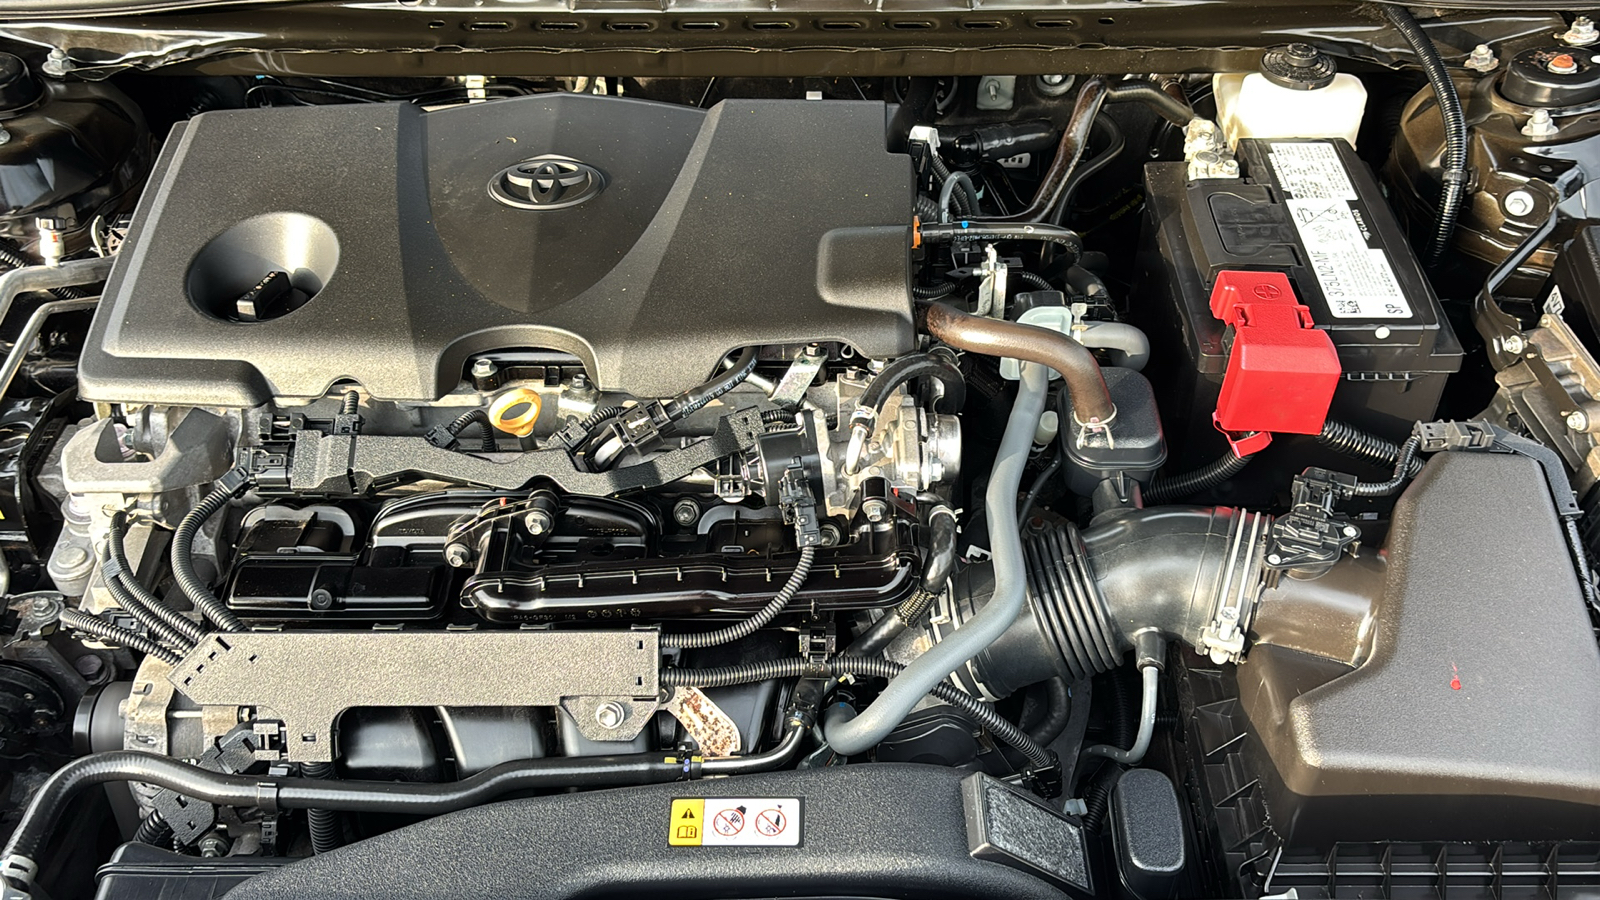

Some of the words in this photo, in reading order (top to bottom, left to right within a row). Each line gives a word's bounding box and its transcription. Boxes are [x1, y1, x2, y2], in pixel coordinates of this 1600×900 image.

[1352, 209, 1368, 231] CLARIOS
[1311, 251, 1345, 297] 375LN2-MF
[1385, 303, 1404, 314] SP
